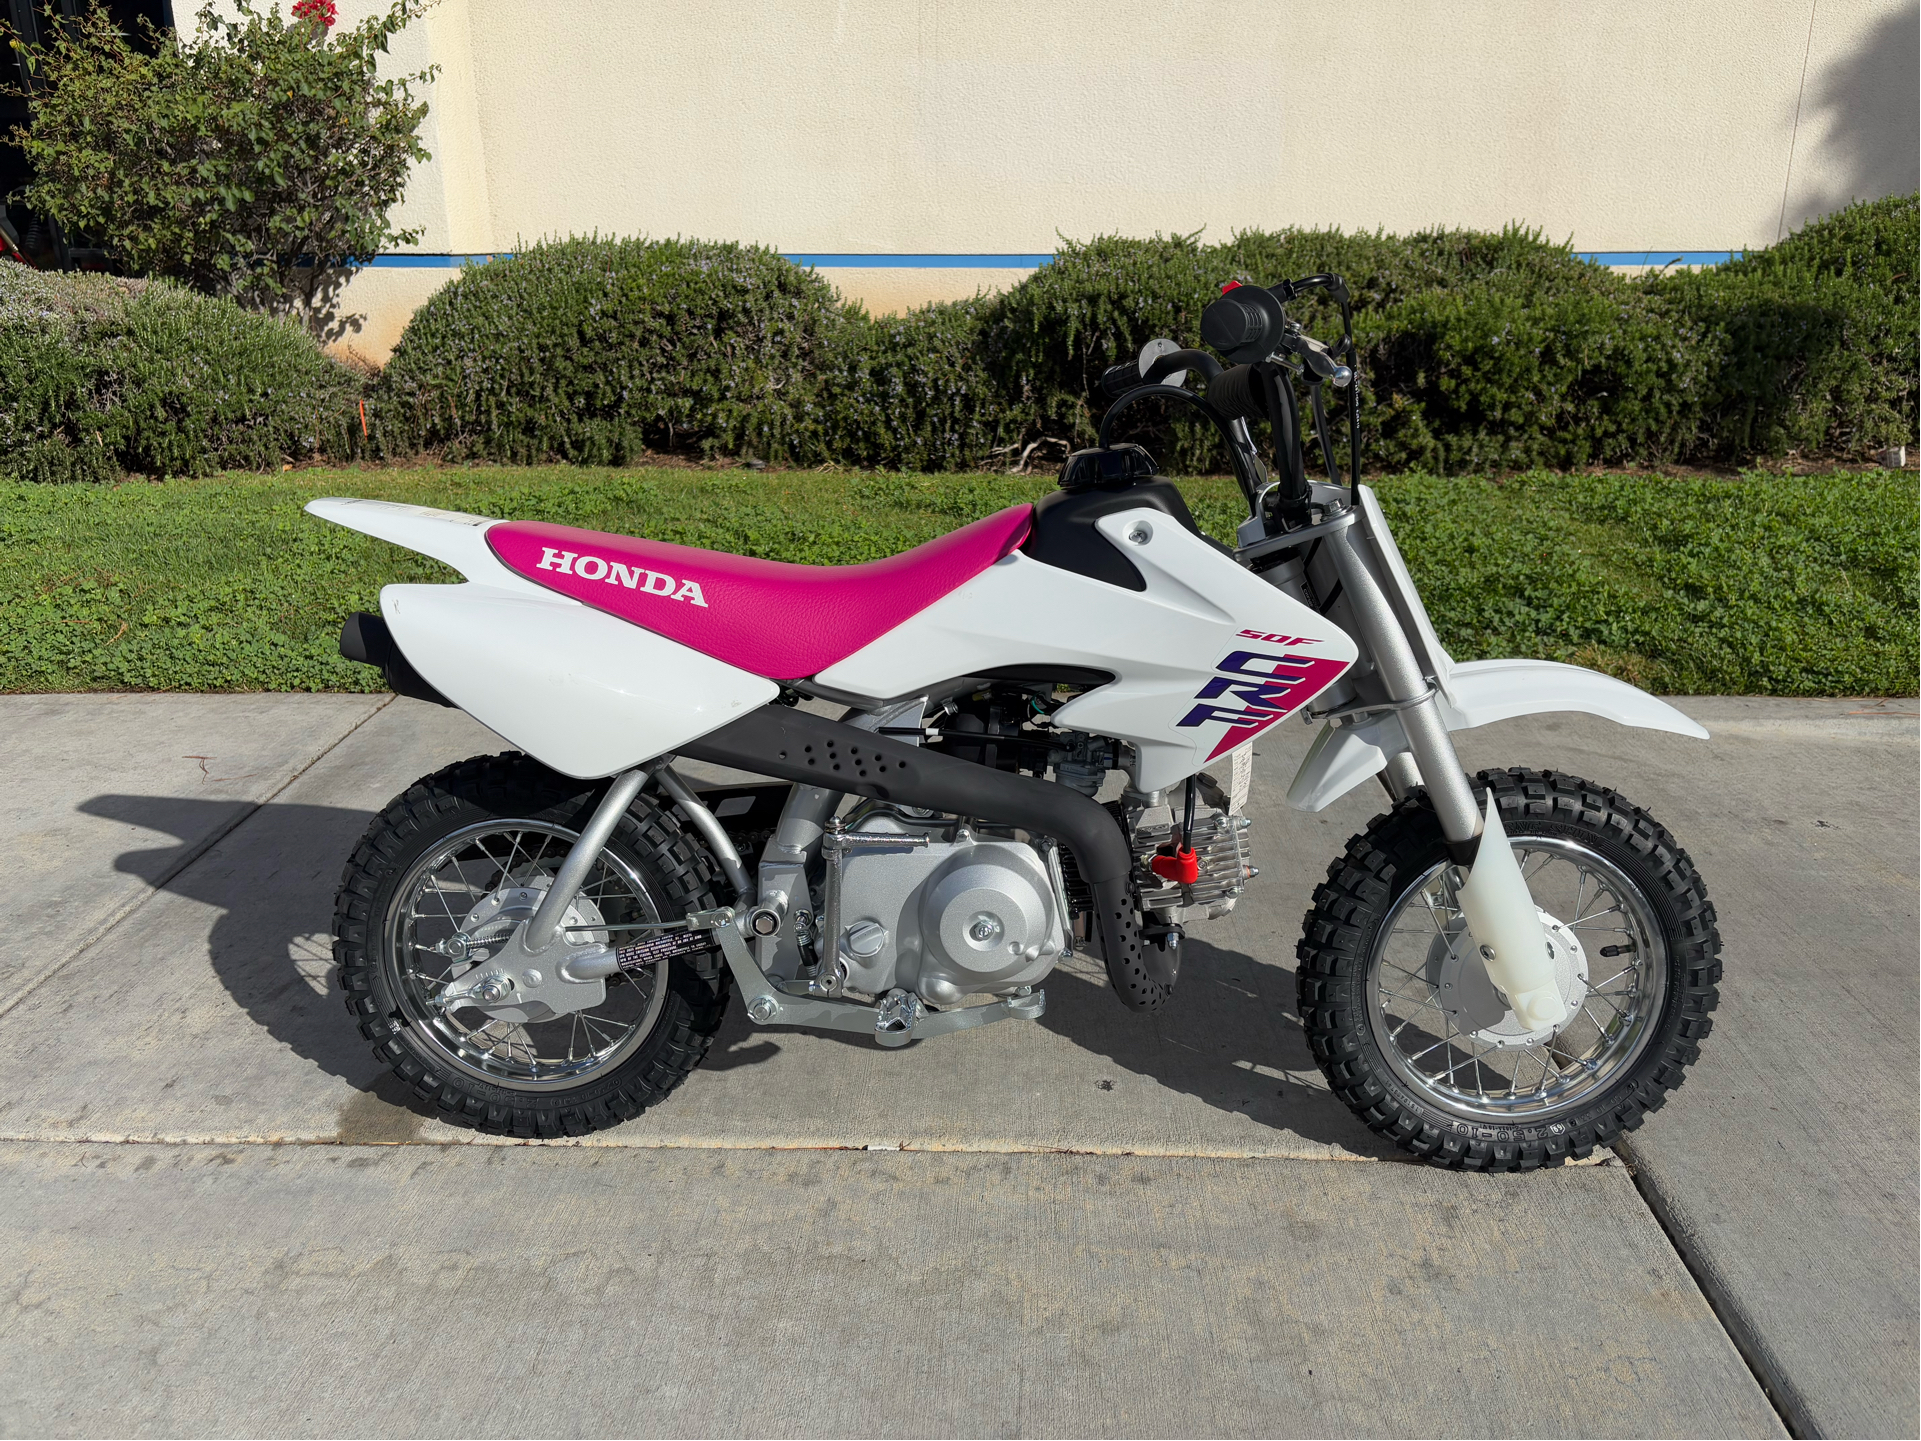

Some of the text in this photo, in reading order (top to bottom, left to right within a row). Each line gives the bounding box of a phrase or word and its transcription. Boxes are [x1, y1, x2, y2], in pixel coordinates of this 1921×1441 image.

[536, 546, 709, 608] HONDA
[1235, 629, 1325, 646] 50F
[1175, 650, 1315, 727] CRF
[1457, 1123, 1550, 1142] 2.50-10
